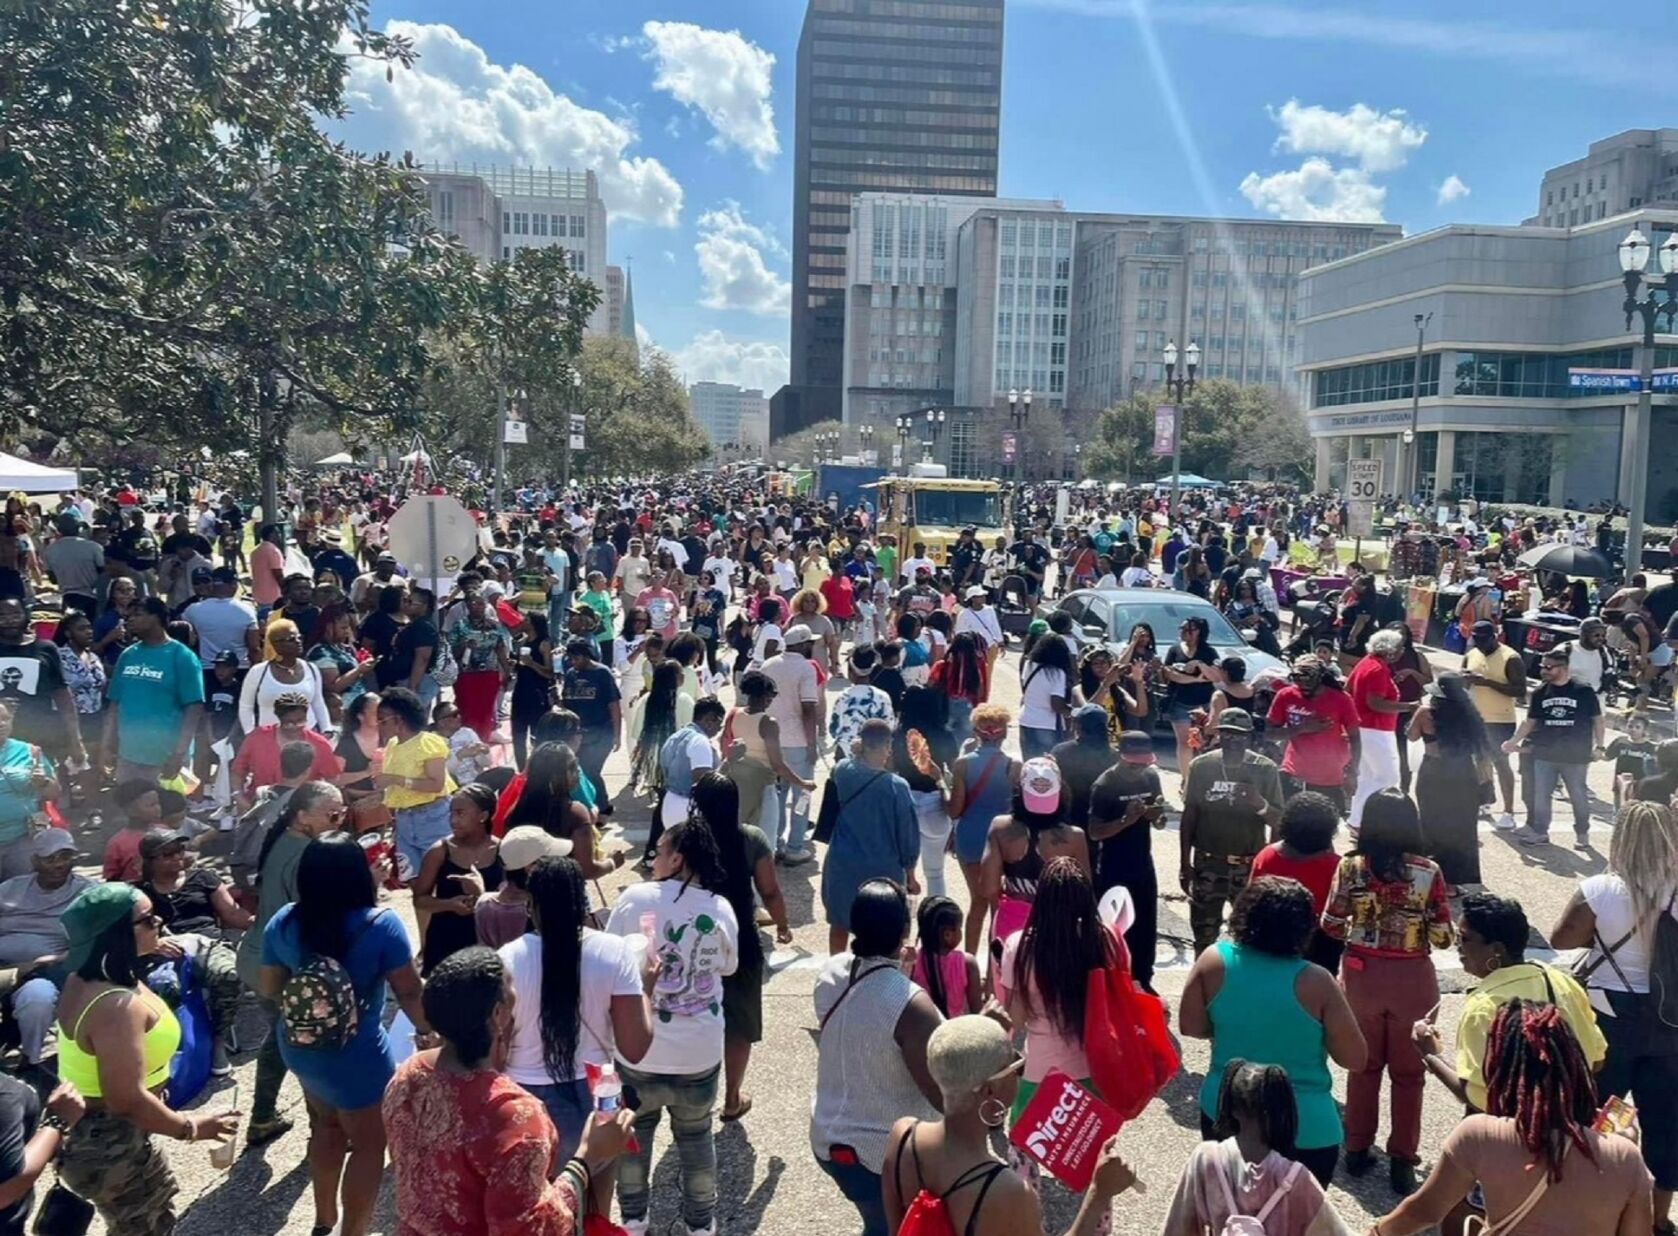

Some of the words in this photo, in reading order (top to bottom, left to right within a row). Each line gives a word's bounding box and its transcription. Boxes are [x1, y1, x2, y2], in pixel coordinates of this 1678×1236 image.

[1352, 464, 1377, 472] SPEED
[1353, 472, 1374, 480] LIMIT
[1351, 481, 1376, 497] 30
[1025, 1082, 1084, 1159] Direct
[1046, 1143, 1062, 1167] AUTO
[1061, 1095, 1092, 1142] INSURANCE
